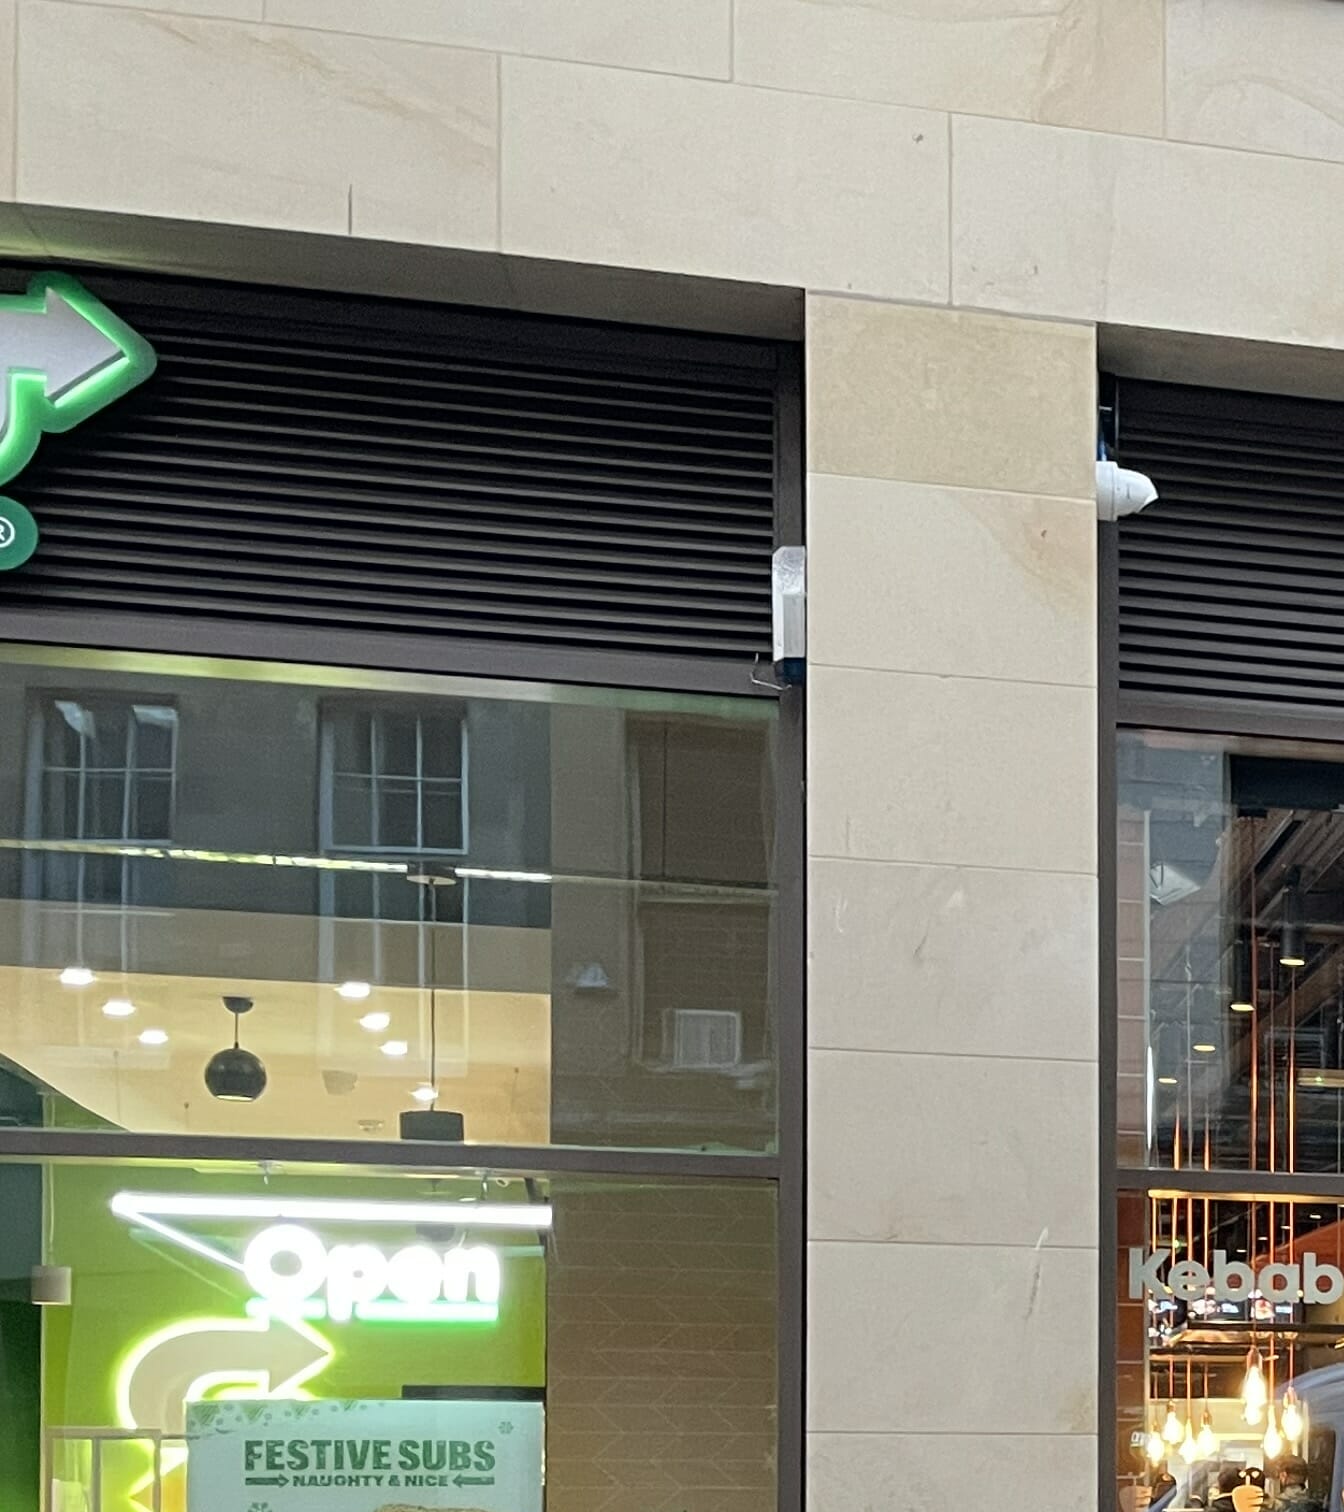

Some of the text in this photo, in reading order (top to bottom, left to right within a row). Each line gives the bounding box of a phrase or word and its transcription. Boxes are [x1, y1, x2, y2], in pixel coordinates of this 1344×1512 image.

[244, 1224, 500, 1321] Open
[244, 1439, 497, 1472] FESTIVE SUBS
[292, 1475, 383, 1488] NAUGHTY
[404, 1475, 449, 1487] NICE
